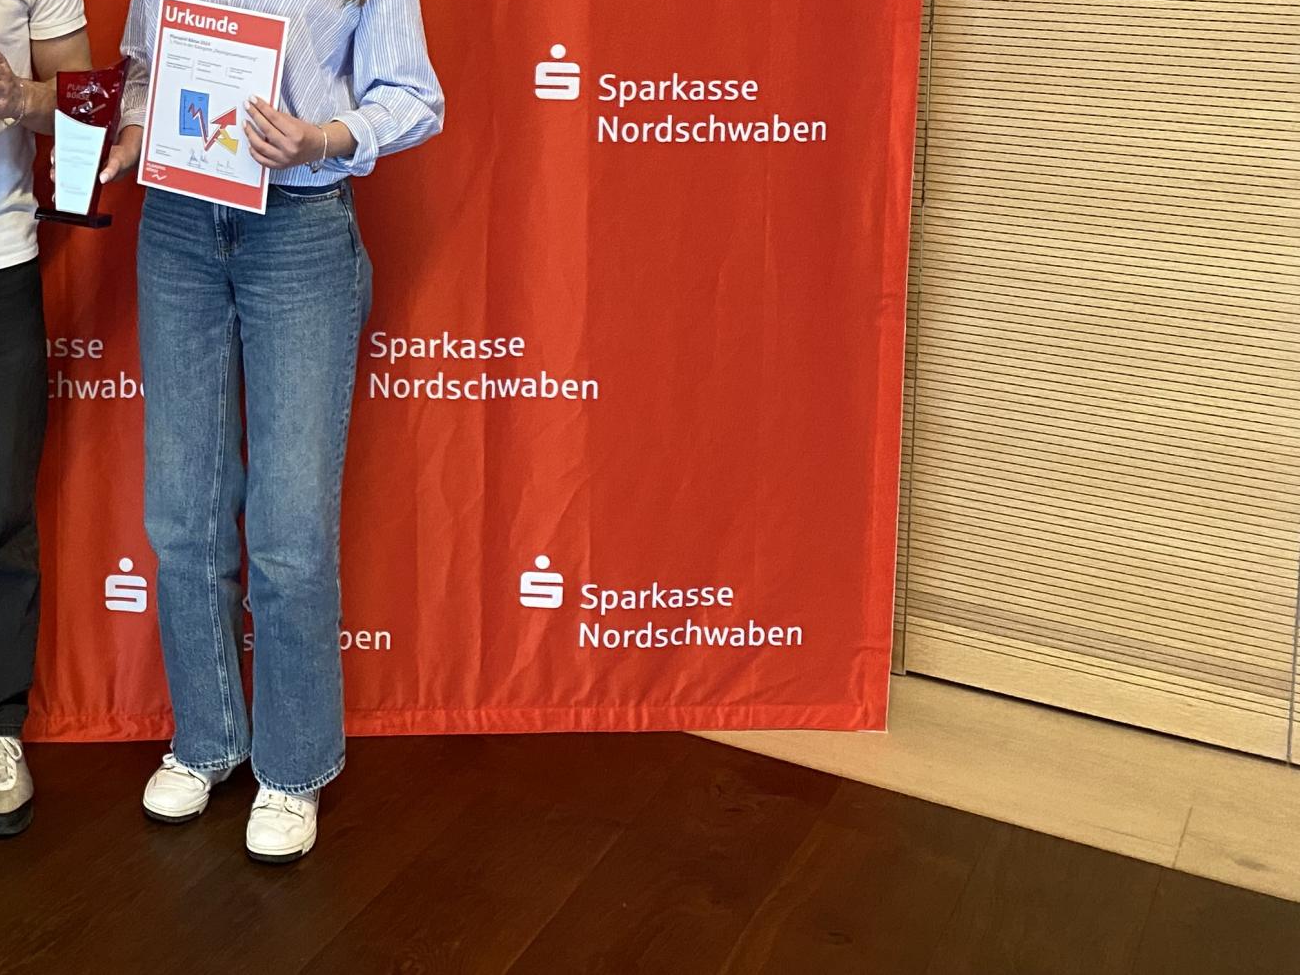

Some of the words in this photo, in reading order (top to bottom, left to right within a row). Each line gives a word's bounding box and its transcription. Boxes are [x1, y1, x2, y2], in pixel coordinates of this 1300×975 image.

[164, 4, 239, 35] Urkunde
[598, 73, 758, 108] Sparkasse
[597, 114, 827, 143] Nordschwaben
[369, 331, 525, 364] Sparkasse
[369, 370, 599, 400] Nordschwaben
[580, 582, 734, 616] Sparkasse
[578, 619, 803, 649] Nordschwaben
